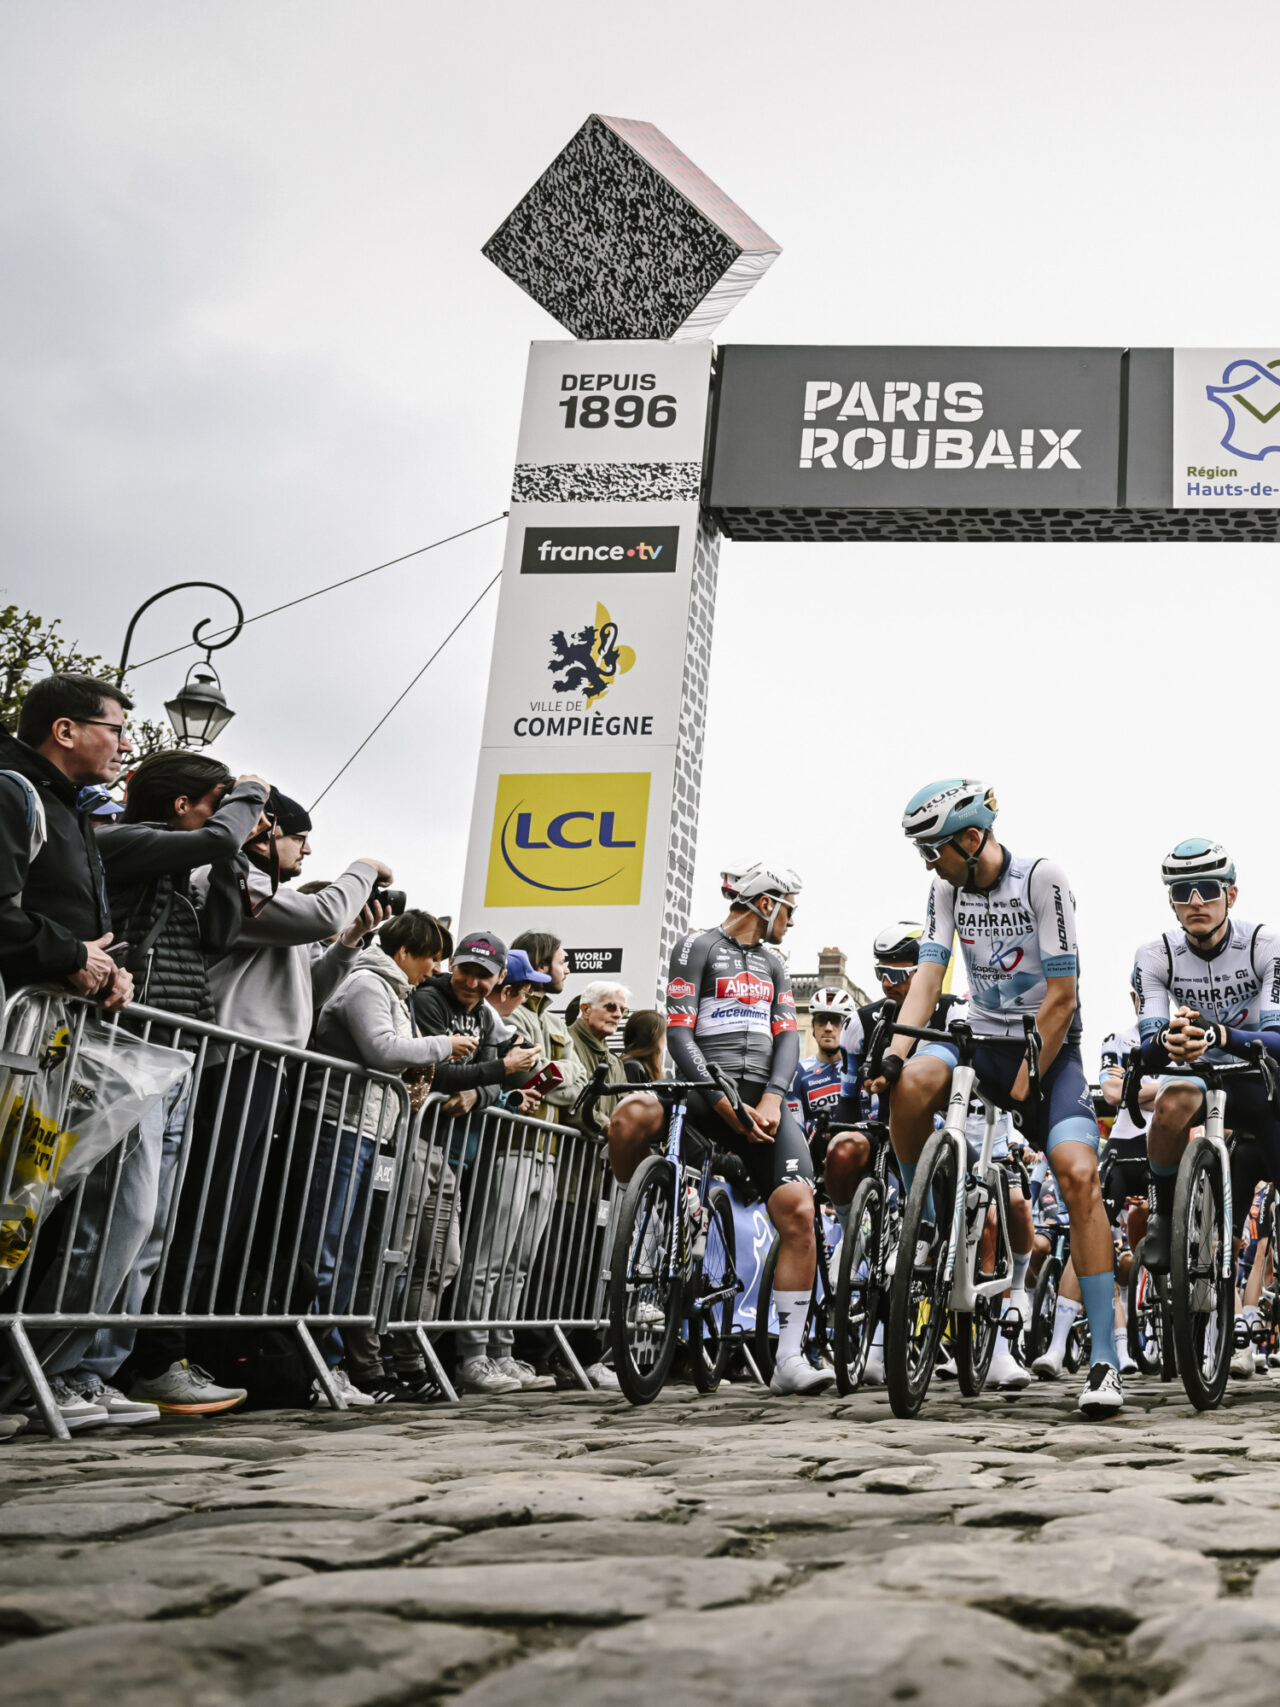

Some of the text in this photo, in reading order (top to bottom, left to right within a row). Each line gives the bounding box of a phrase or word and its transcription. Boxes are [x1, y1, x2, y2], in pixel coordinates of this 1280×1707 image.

[561, 373, 657, 392] DEPUIS
[804, 381, 984, 422] PARIS
[559, 395, 677, 429] 1896
[800, 427, 1082, 470] ROUBAIX
[1187, 466, 1238, 479] Région
[530, 701, 582, 712] VILLE DE
[513, 711, 653, 736] COMPIÈGNE
[921, 786, 967, 812] RUDY
[515, 811, 636, 849] LCL
[958, 910, 1031, 927] BAHRAIN
[1052, 884, 1068, 952] MERIDA
[959, 925, 1034, 937] VICTORIOUS
[574, 952, 612, 961] WORLD
[575, 961, 603, 970] TOUR
[668, 984, 691, 994] Alpecin
[725, 980, 770, 997] Alpecin
[1174, 980, 1258, 1002] BAHRAIN
[686, 1041, 710, 1078] WHOOP
